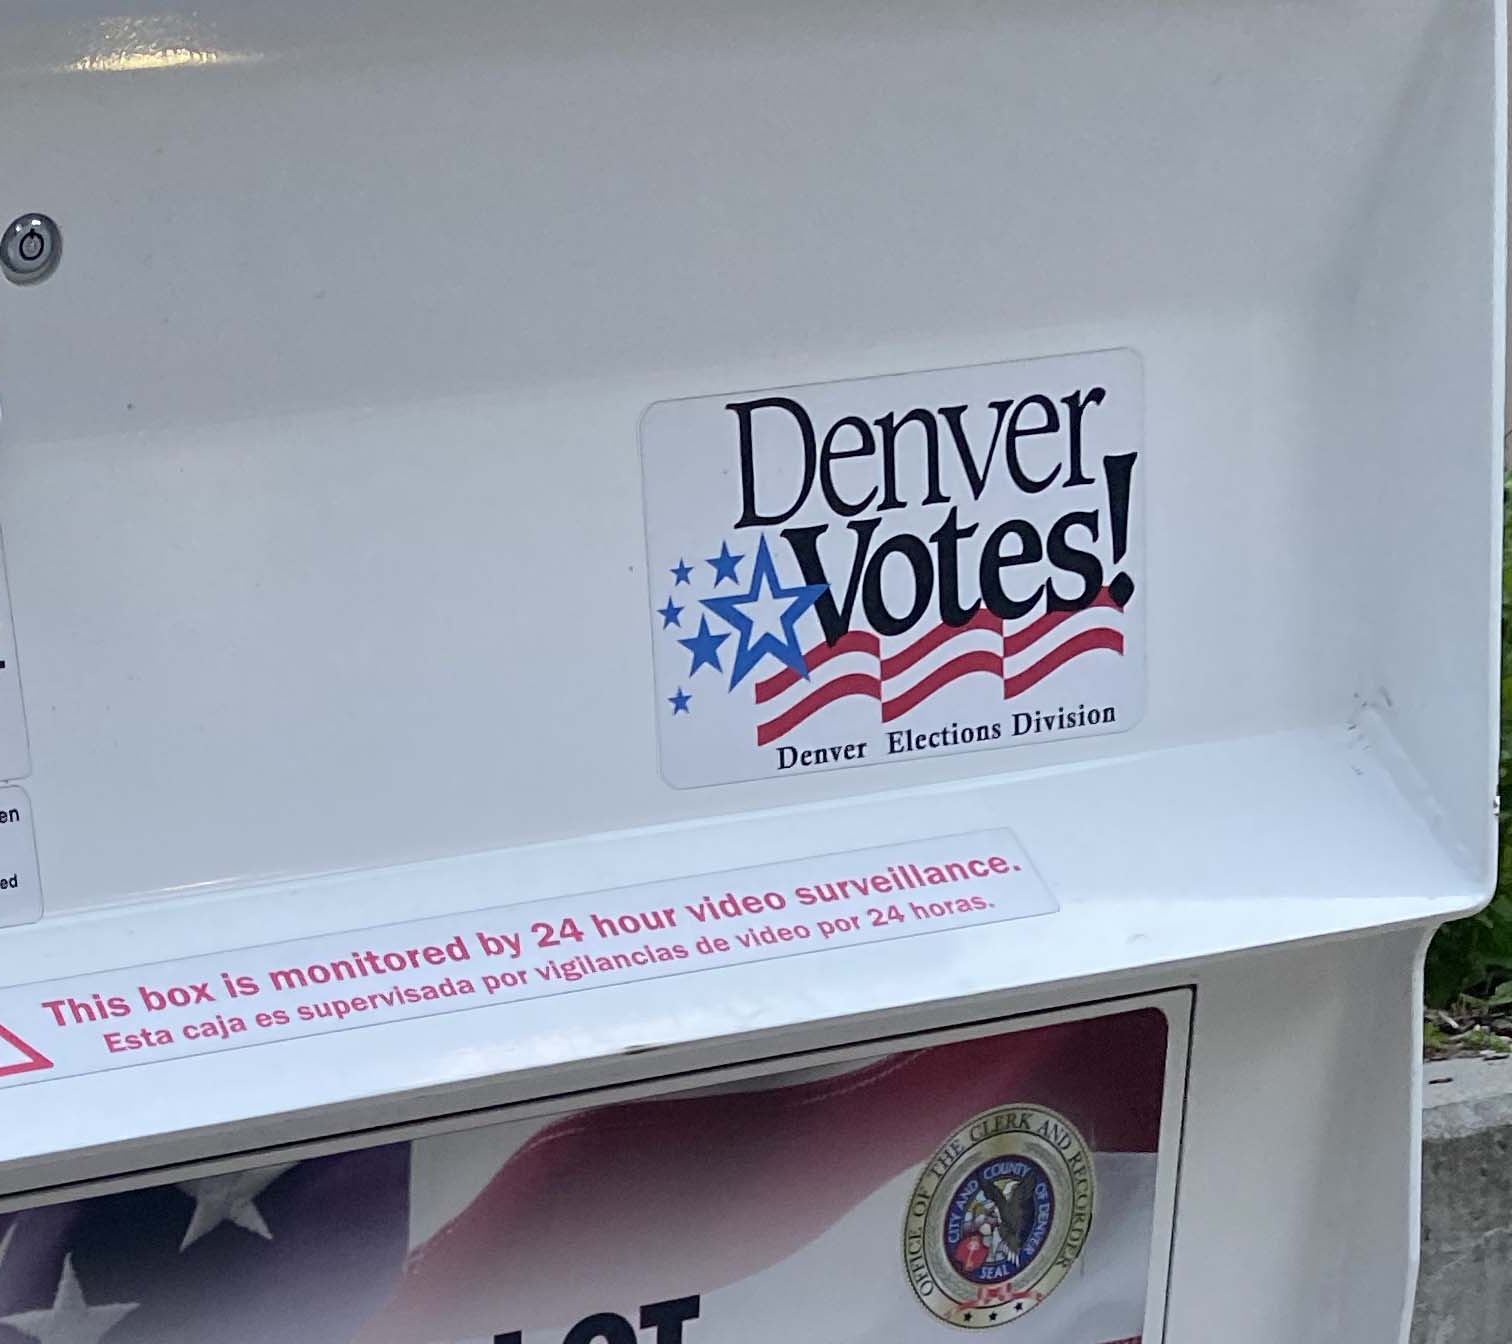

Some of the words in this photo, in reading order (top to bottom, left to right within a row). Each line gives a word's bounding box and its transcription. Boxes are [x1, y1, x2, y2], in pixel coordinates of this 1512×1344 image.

[725, 386, 1107, 530] Denver
[781, 451, 1138, 648] Votes!
[776, 738, 868, 769] Denver
[888, 717, 1002, 755] Elections
[1011, 704, 1117, 737] Division
[42, 994, 131, 1028] This
[139, 981, 215, 1015] box
[221, 972, 260, 999] is
[268, 936, 470, 992] monitored
[476, 930, 521, 958] by
[530, 917, 584, 948] 24
[590, 907, 679, 939] hour
[685, 888, 786, 924] video
[795, 853, 1022, 907] surveillance.
[103, 1029, 174, 1054] Esta
[182, 1014, 248, 1041] caja
[254, 1008, 290, 1028] es
[296, 977, 475, 1021] supervisada
[482, 970, 528, 995] por
[533, 940, 689, 983] vigilancias
[696, 934, 731, 956] de
[736, 920, 811, 948] video
[817, 914, 863, 939] por
[867, 904, 905, 928] 24
[909, 893, 996, 921] horas.
[930, 1141, 966, 1179] THE
[969, 1112, 1034, 1142] CLERK
[1038, 1119, 1072, 1150] AND
[914, 1187, 931, 1217] OF
[948, 1210, 962, 1244] CITY
[958, 1179, 979, 1209] AND
[983, 1161, 1031, 1180] COUNTY
[1056, 1151, 1089, 1268] RECORDER
[908, 1224, 934, 1297] OFFICE
[979, 1265, 1010, 1279] SEAL
